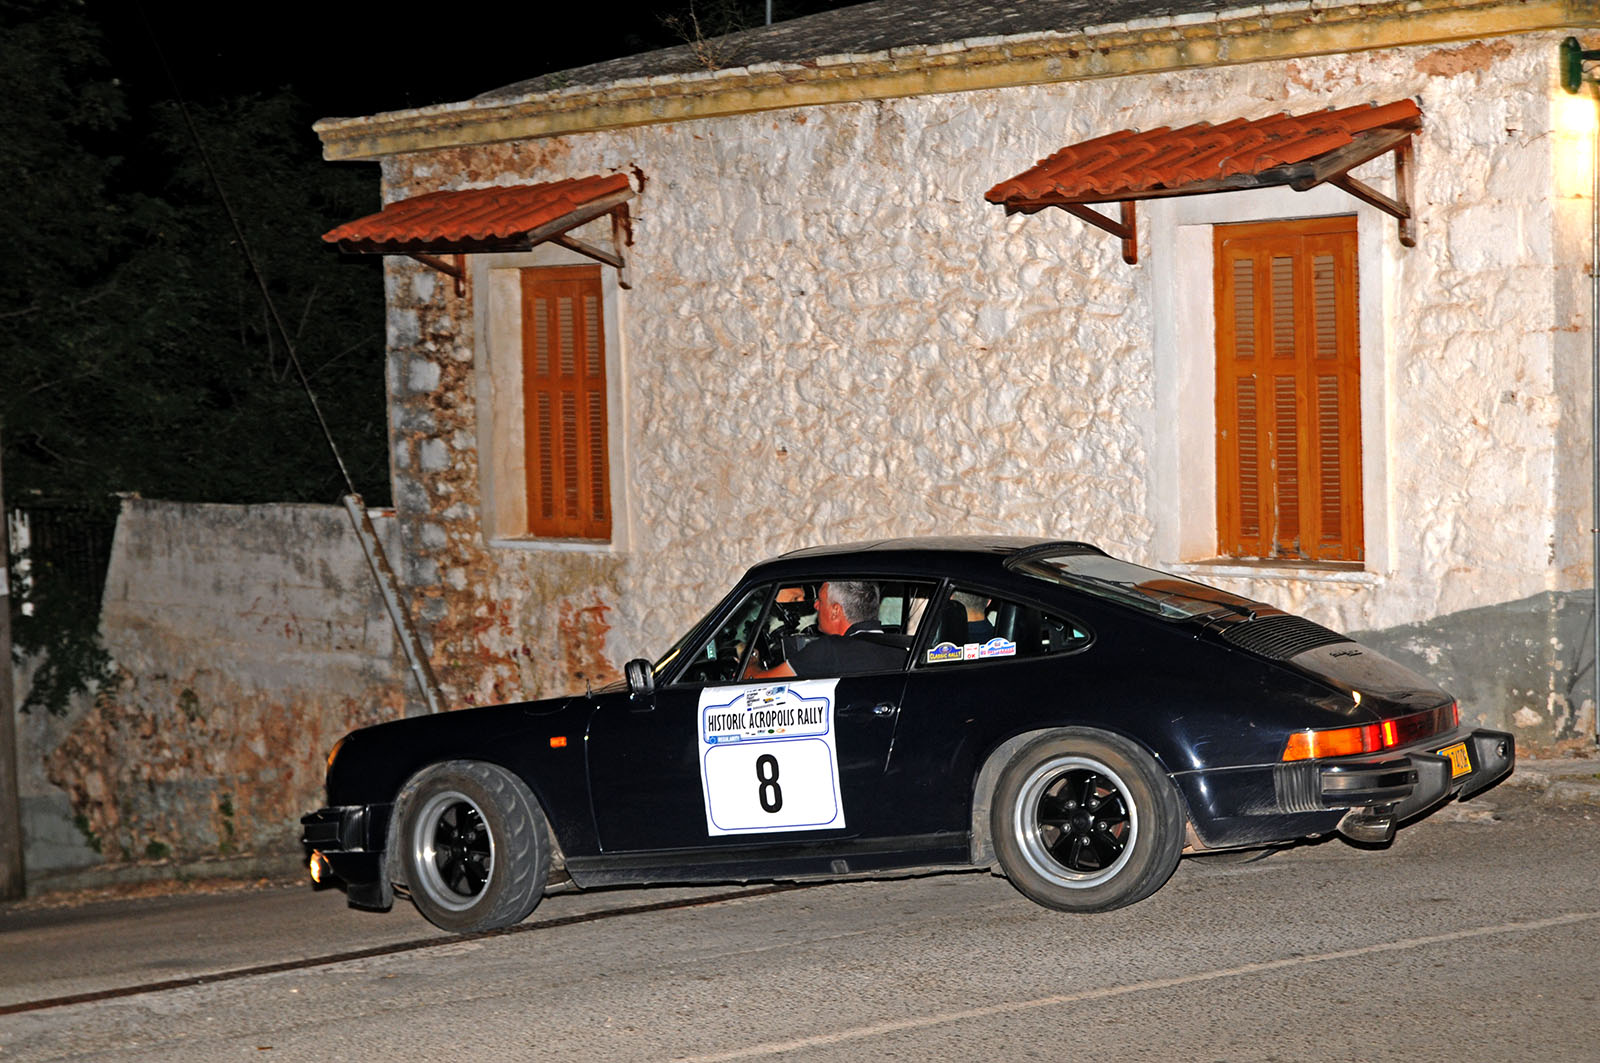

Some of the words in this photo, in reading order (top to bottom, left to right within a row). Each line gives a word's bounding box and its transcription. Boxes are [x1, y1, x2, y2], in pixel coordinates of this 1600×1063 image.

[708, 713, 746, 732] HISTORIC
[749, 709, 794, 729] ACROPOLIS
[797, 707, 824, 725] RALLY
[756, 753, 783, 814] 8
